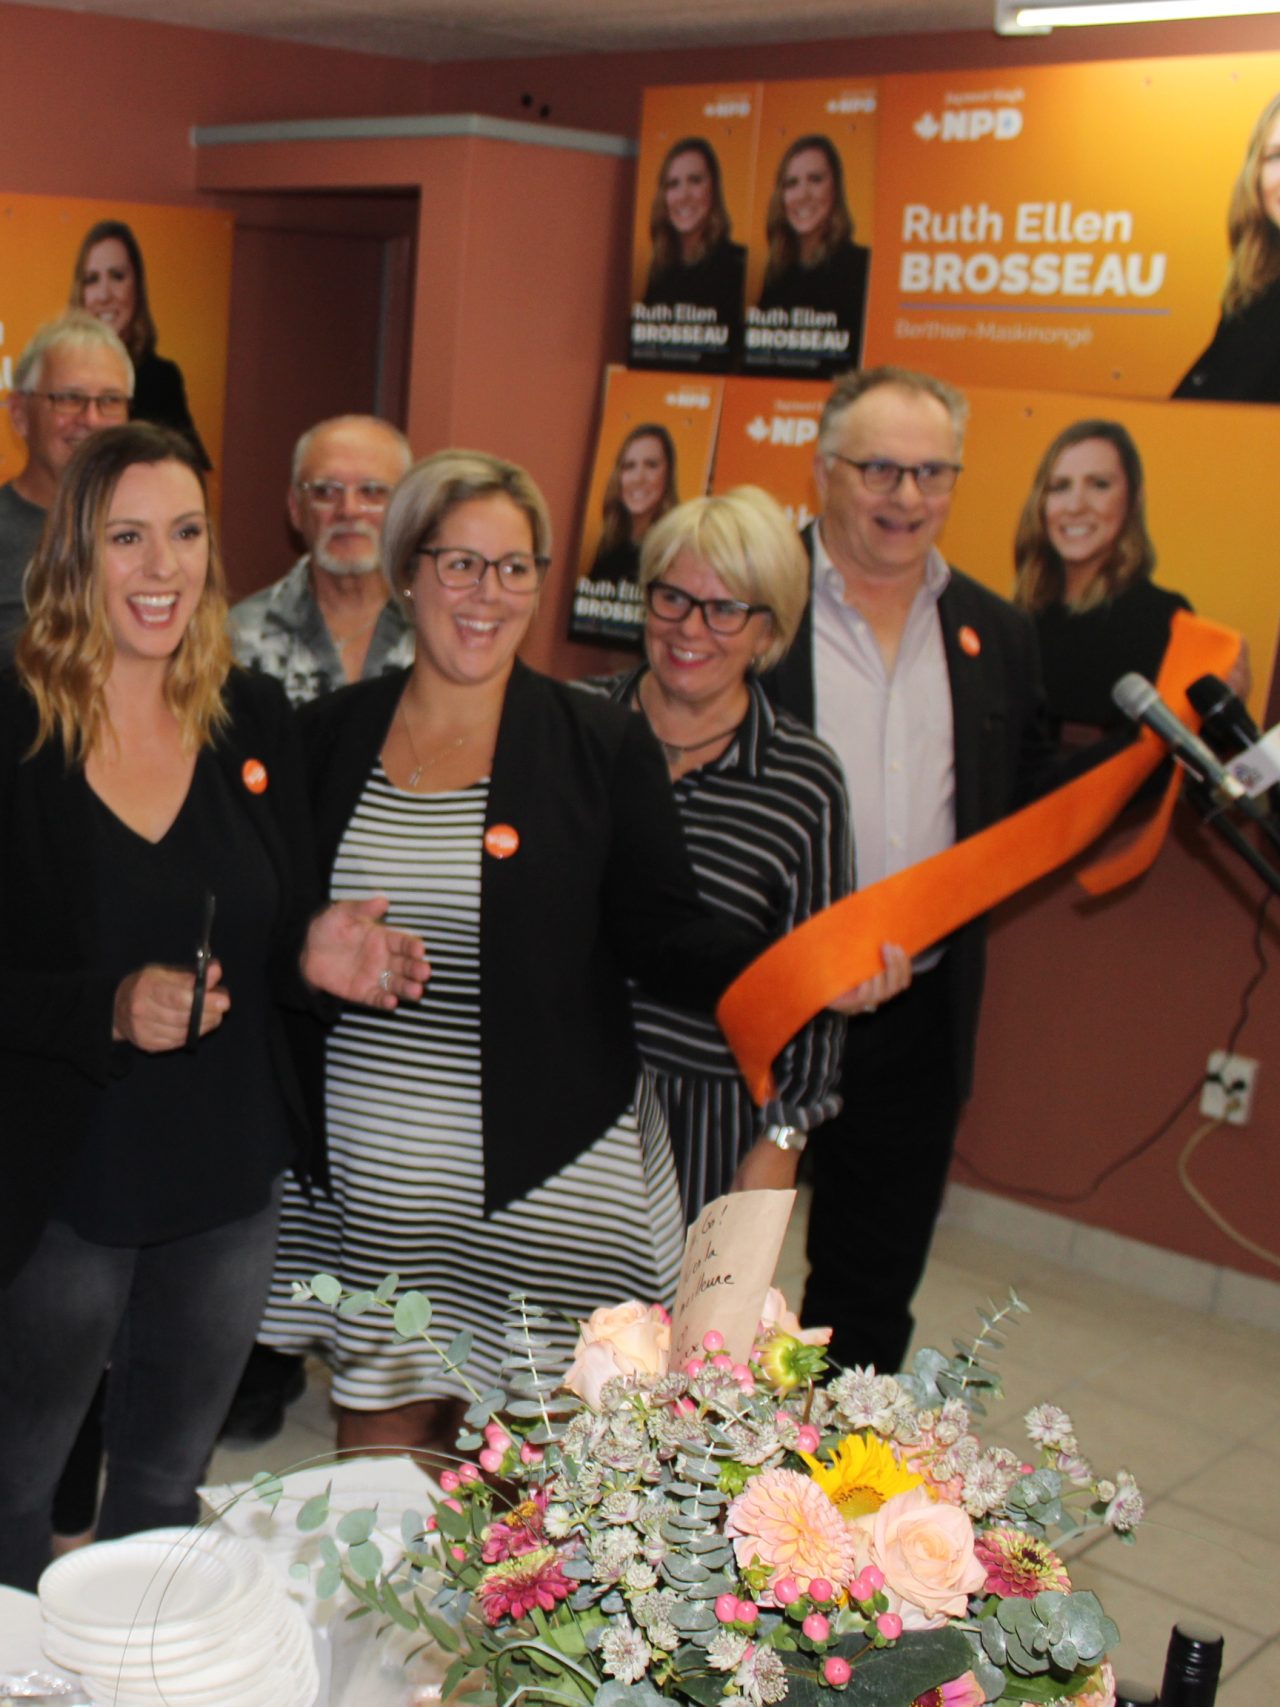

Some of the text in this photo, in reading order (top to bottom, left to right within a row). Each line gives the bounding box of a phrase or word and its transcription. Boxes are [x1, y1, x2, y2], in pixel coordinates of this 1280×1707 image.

[942, 108, 1023, 142] NPD
[902, 201, 1133, 243] Ruth Ellen
[899, 252, 1166, 296] BROSSEAU
[632, 303, 717, 323] Ruth Ellen
[745, 307, 838, 328] Ruth Ellen
[632, 323, 728, 346] BROSSEAU
[745, 327, 849, 351] BROSSEAU
[771, 417, 818, 446] NP
[577, 576, 616, 598] Ruth
